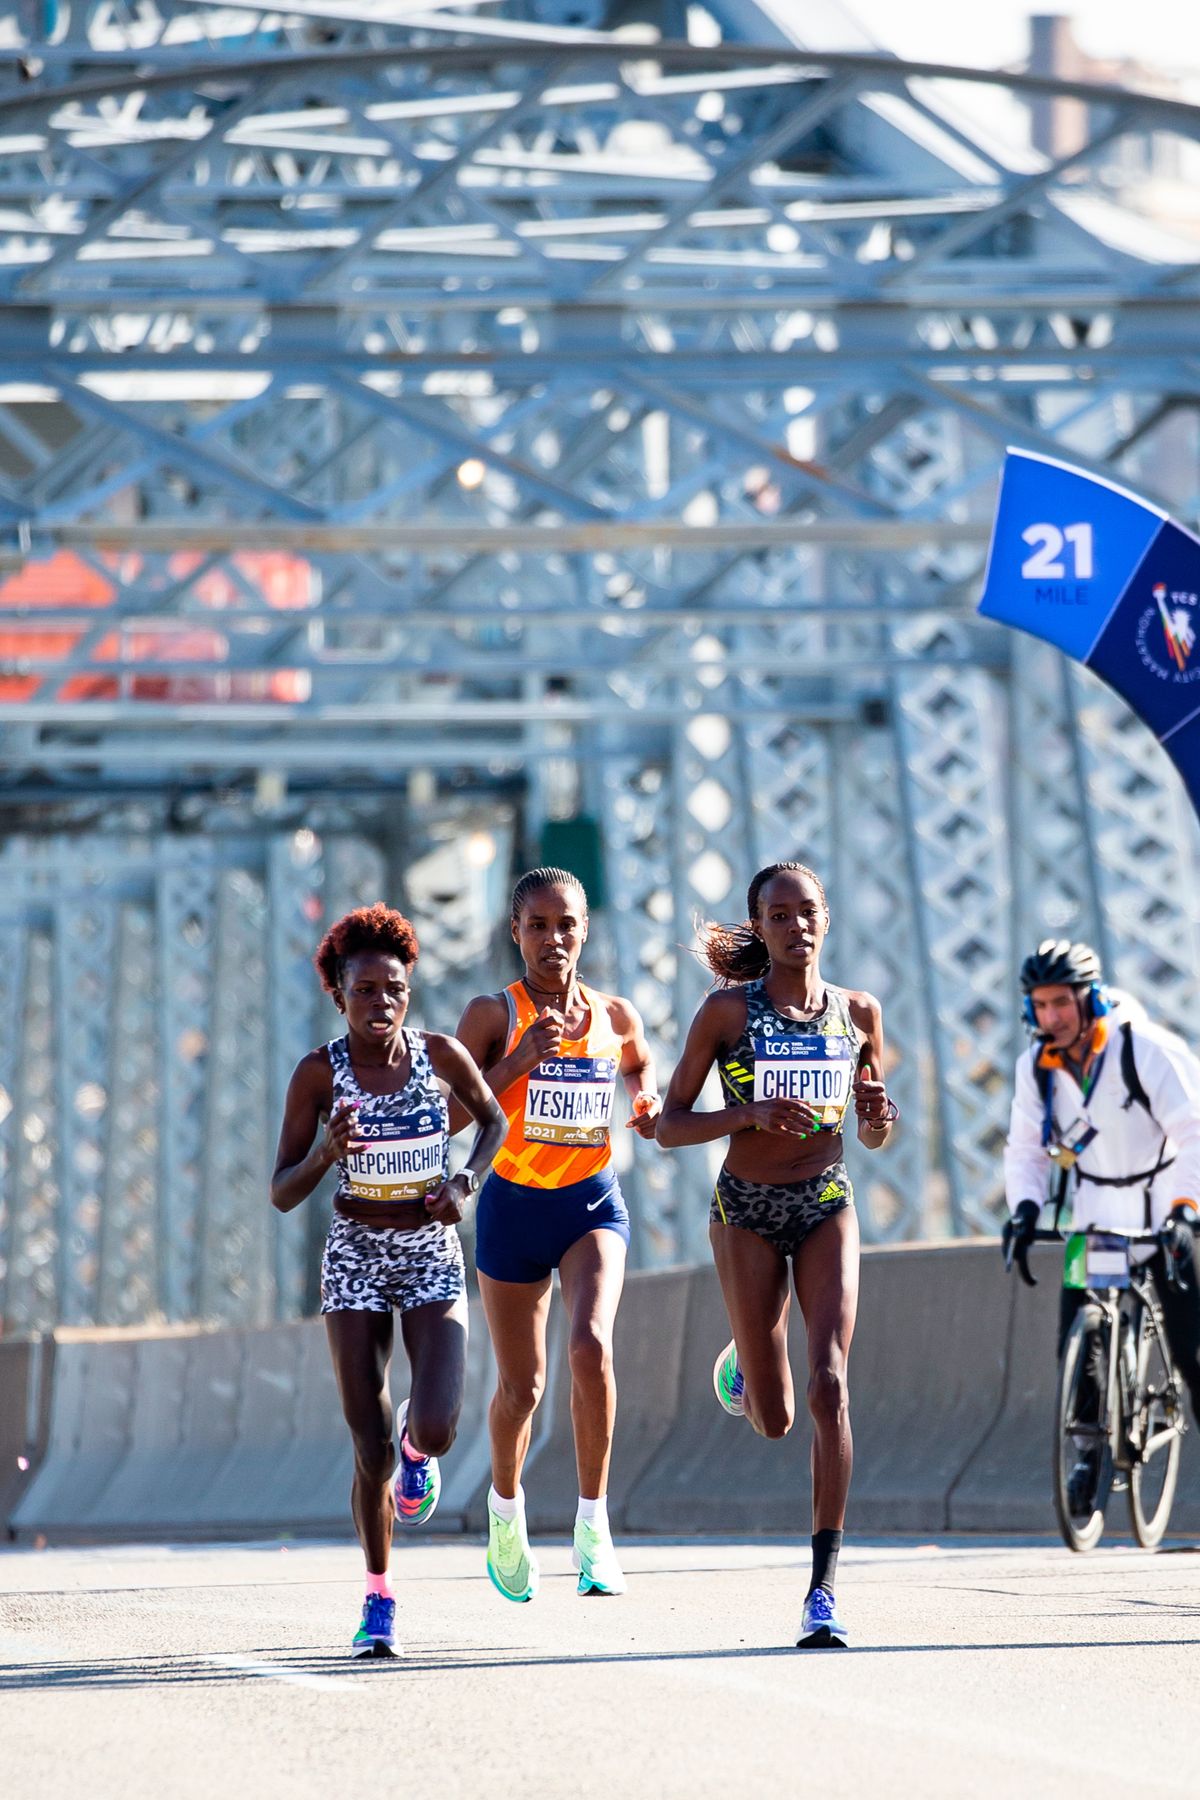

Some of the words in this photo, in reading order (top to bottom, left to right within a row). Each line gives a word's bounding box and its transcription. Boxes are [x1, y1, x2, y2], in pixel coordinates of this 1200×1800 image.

[1021, 523, 1093, 579] 21
[1035, 585, 1089, 605] MILE
[1170, 591, 1198, 606] TCS
[763, 1069, 842, 1099] CHEPTOO
[529, 1088, 611, 1120] YESHANEH
[524, 1126, 556, 1138] 2021
[350, 1144, 441, 1175] JEPCHIRCHIR
[352, 1184, 382, 1197] 2021
[818, 1190, 845, 1203] adidas
